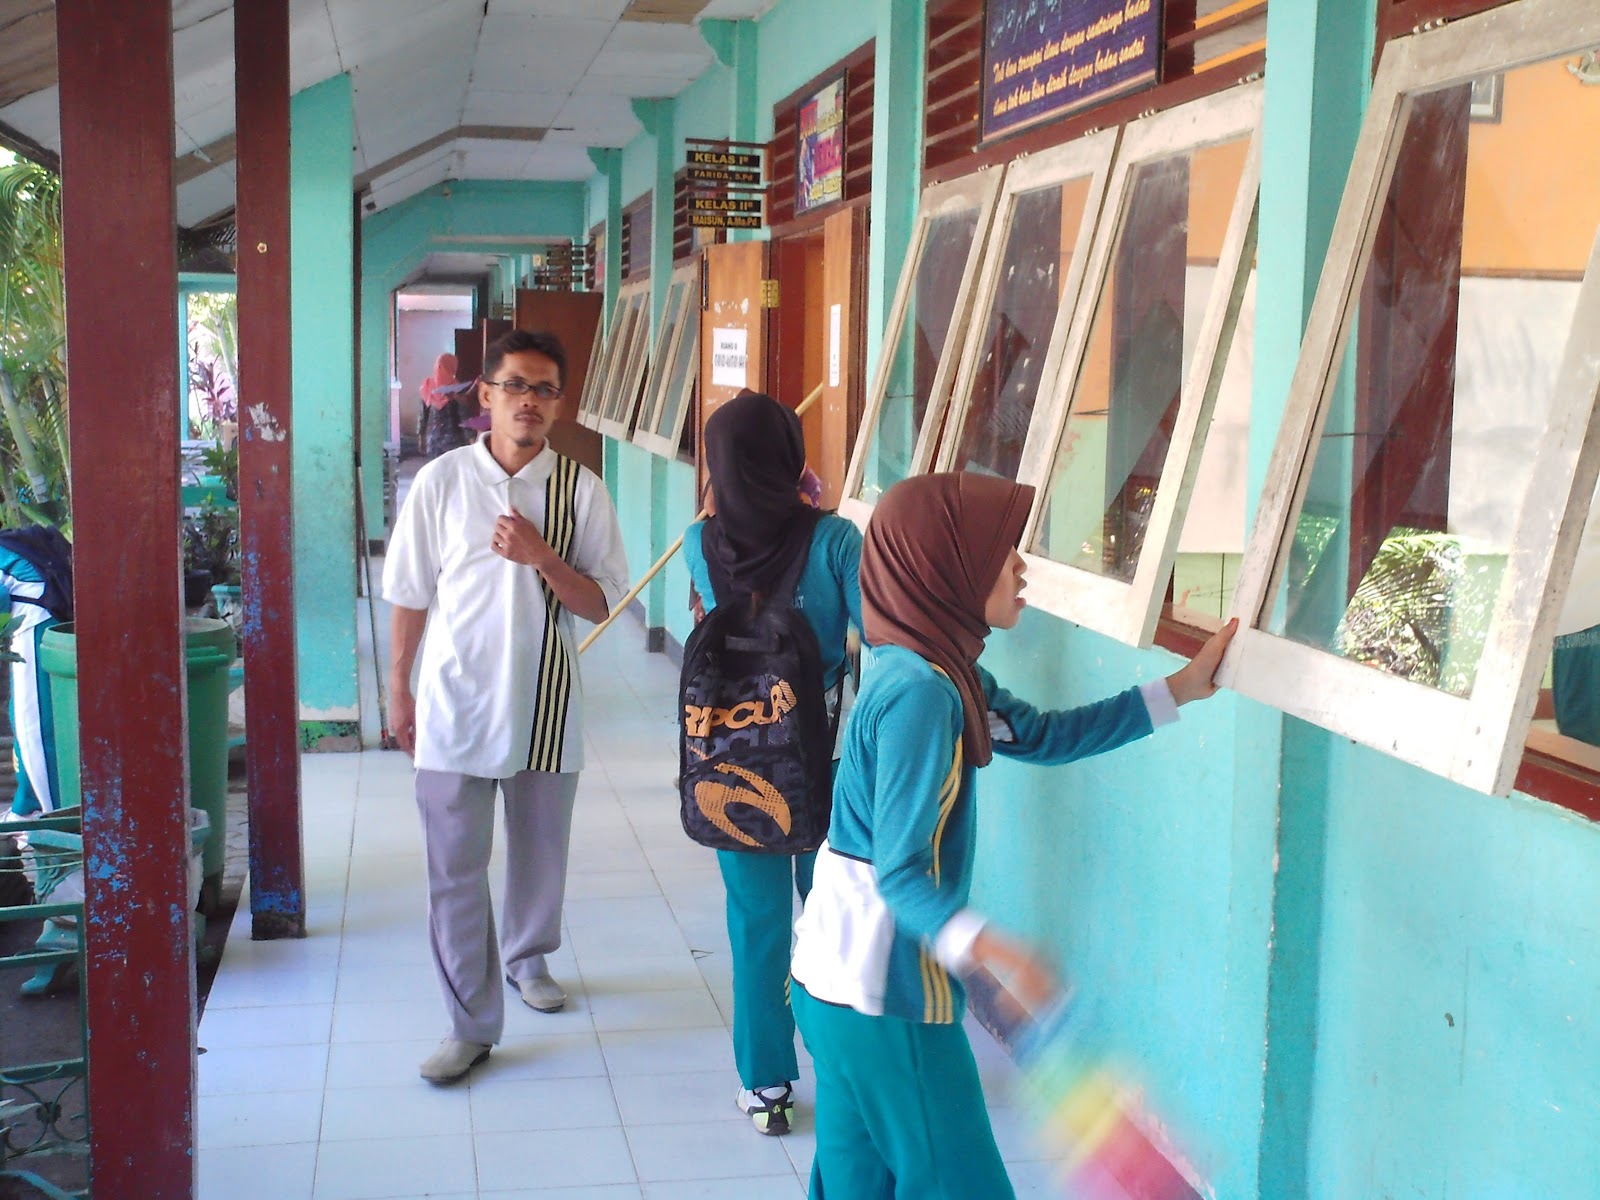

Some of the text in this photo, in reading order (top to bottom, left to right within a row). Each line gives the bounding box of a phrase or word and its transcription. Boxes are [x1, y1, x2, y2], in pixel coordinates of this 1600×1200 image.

[695, 152, 736, 165] KELAS
[694, 170, 753, 181] FARIDA, S.Pd
[695, 199, 736, 210] KELAS
[693, 215, 726, 226] MAISUN,
